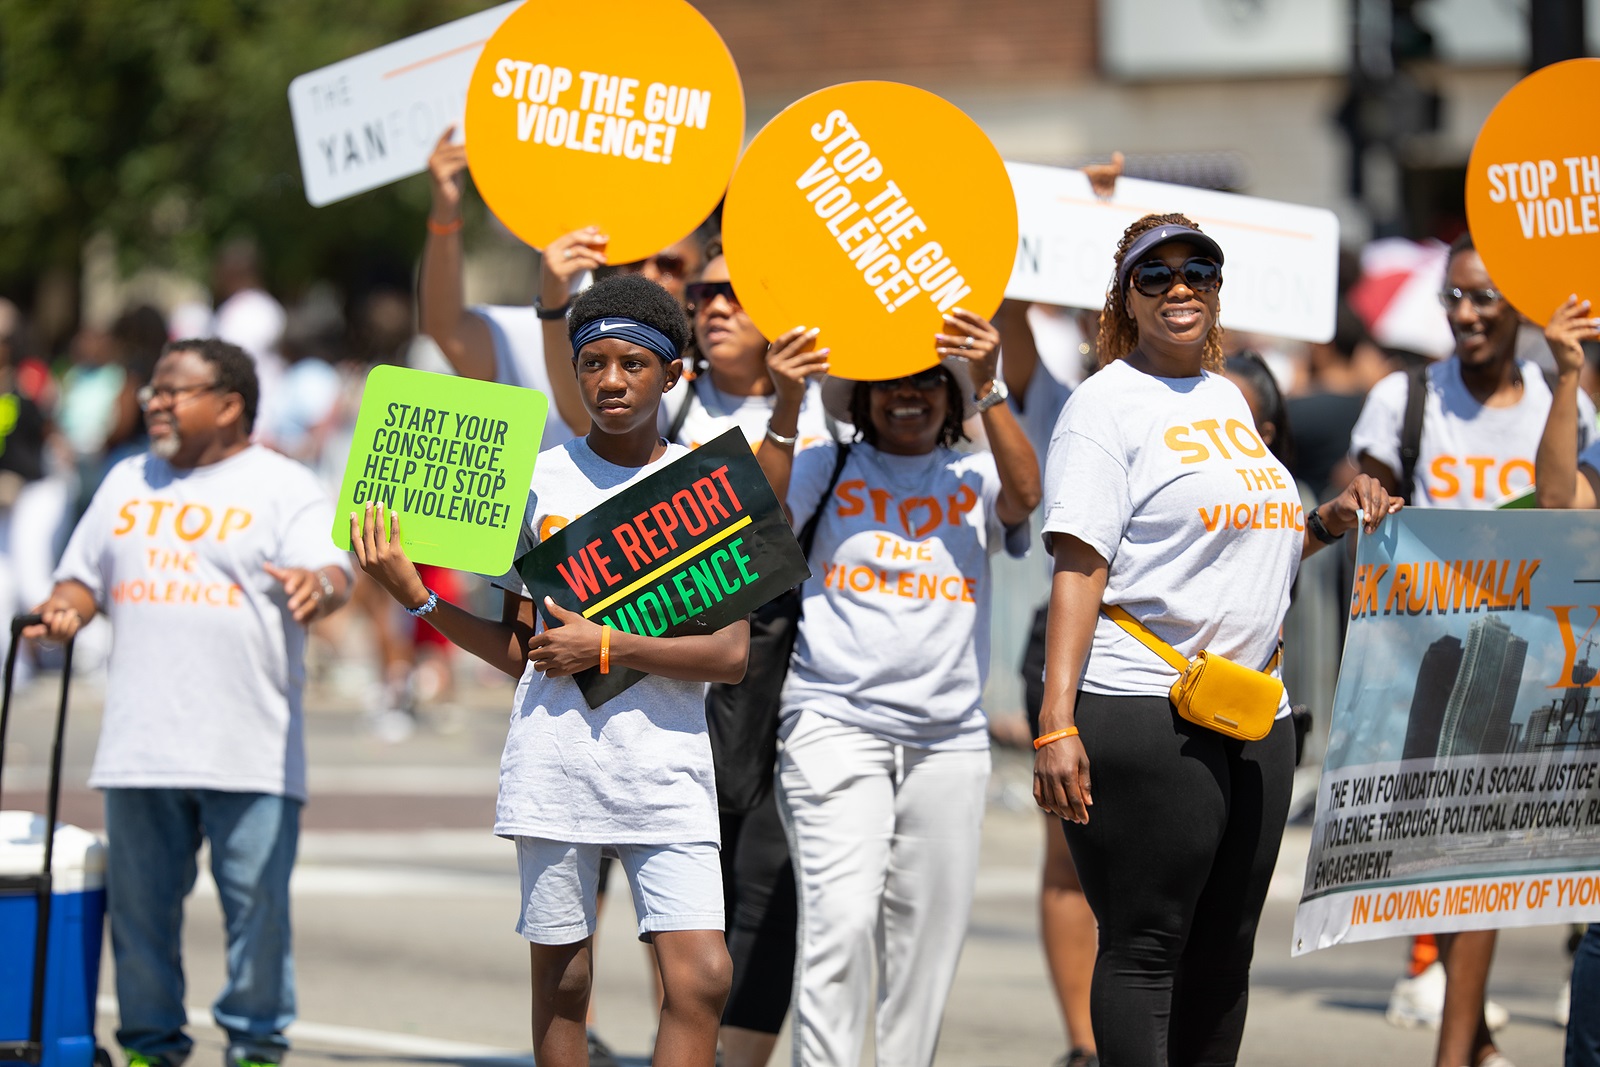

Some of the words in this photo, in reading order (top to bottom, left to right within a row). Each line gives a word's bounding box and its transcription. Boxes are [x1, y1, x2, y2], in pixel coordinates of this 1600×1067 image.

[309, 75, 353, 115] THE
[492, 58, 572, 105] STOP
[579, 71, 640, 118] THE
[643, 82, 711, 130] GUN
[517, 101, 677, 165] VIOLENCE!
[1487, 159, 1558, 204] STOP
[1563, 155, 1600, 196] TH
[795, 155, 921, 314] VIOLENCE!
[810, 109, 884, 185] STOP
[864, 179, 928, 252] THE
[905, 241, 972, 313] GUN
[1515, 194, 1600, 239] VIOLE
[384, 402, 450, 435] START
[455, 413, 509, 446] YOUR
[1163, 418, 1267, 464] STO
[363, 454, 417, 484] HELP
[423, 463, 449, 491] TO
[452, 468, 506, 500] STOP
[372, 428, 505, 478] CONSCIENCE,
[1235, 467, 1286, 491] THE
[113, 499, 253, 542] STOP
[352, 480, 397, 510] GUN
[403, 487, 511, 529] VIOLENCE!
[835, 478, 977, 539] STOP
[555, 537, 623, 603] WE
[611, 464, 744, 572] REPORT
[875, 533, 932, 561] THE
[147, 548, 197, 573] THE
[822, 561, 977, 603] VIOLENCE
[1350, 563, 1390, 620] 5K
[1384, 559, 1542, 616] RUNWALK
[1328, 779, 1349, 812] THE
[1350, 776, 1375, 807] YAN
[1375, 769, 1456, 804] FOUNDATION
[1459, 768, 1475, 796] IS
[1474, 767, 1486, 795] A
[1487, 764, 1537, 795] SOCIAL
[1539, 762, 1598, 792] JUSTICE
[1322, 813, 1376, 850] VIOLENCE
[1378, 807, 1439, 841] THROUGH
[1440, 800, 1507, 834] POLITICAL
[1509, 798, 1583, 831] ADVOCACY,
[1313, 850, 1393, 890] ENGAGEMENT.
[1351, 895, 1372, 926] IN
[1372, 887, 1441, 923] LOVING
[1442, 881, 1526, 917] MEMORY
[1526, 878, 1553, 910] OF
